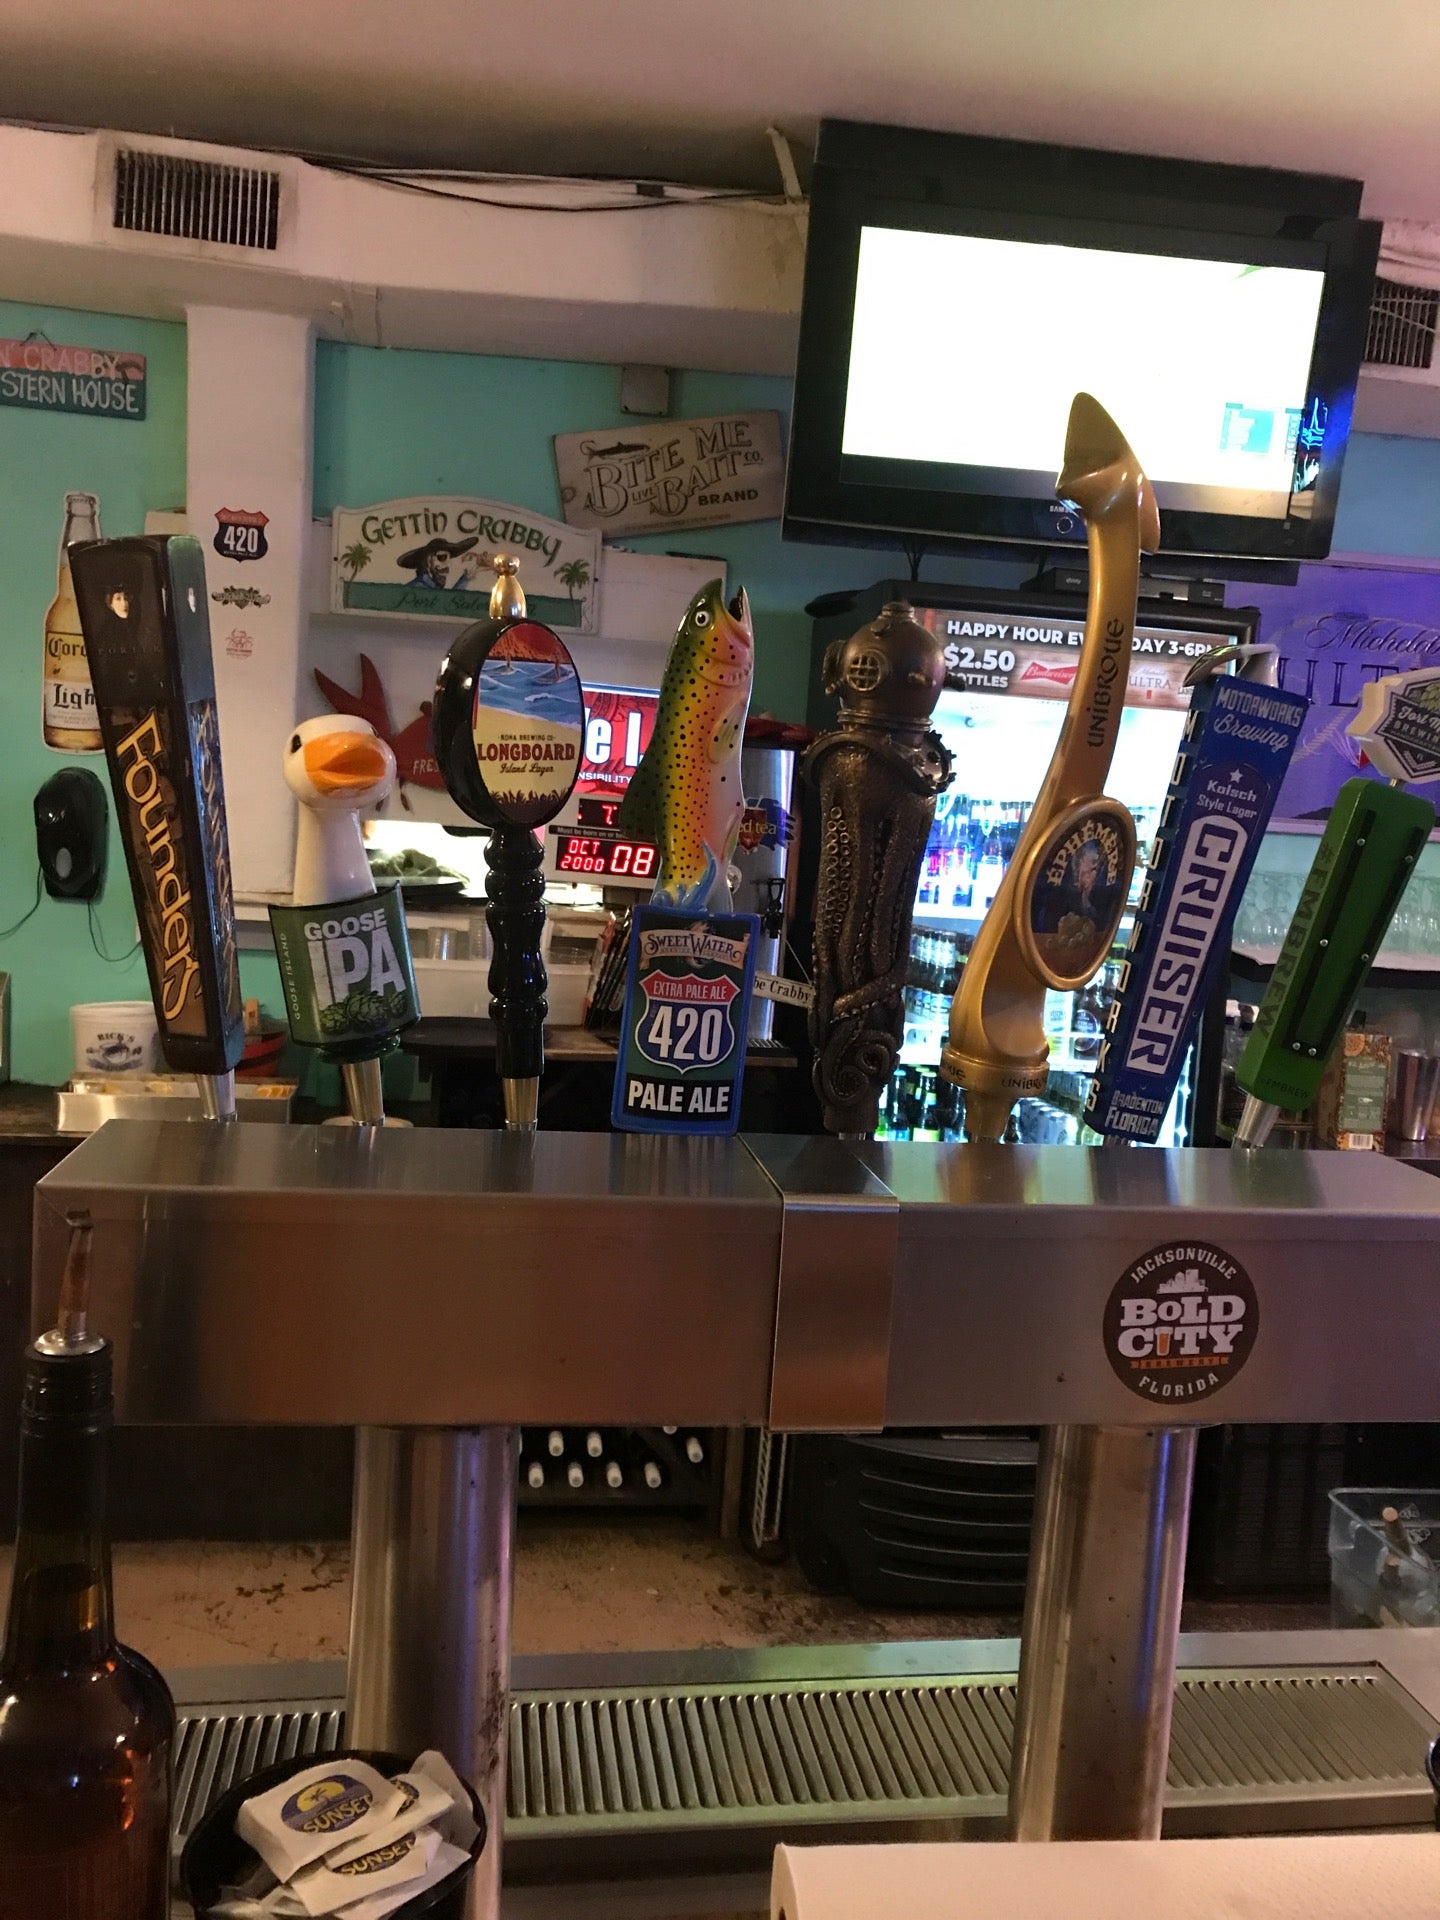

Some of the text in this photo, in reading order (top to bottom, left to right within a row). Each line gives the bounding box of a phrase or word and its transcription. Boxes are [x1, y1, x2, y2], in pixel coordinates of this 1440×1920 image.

[24, 346, 119, 380] CRABBY
[72, 378, 140, 413] HOUSE
[583, 420, 752, 517] BITE ME
[650, 450, 743, 517] BAIT
[698, 489, 759, 506] BRAND
[224, 525, 259, 553] 420
[947, 620, 1008, 639] HAPPY
[1013, 627, 1063, 644] HOUR
[1168, 641, 1221, 657] 3-6P
[943, 642, 1016, 672] $2.50
[1129, 676, 1172, 690] ULTRA
[1215, 686, 1304, 728] MOTORWORKS
[1213, 714, 1289, 753] Brewing
[477, 743, 575, 761] LONGBOARD
[500, 762, 554, 776] Island Lager
[1196, 794, 1258, 819] Style Lager
[1207, 780, 1257, 802] Kolsch
[756, 822, 776, 834] tea
[116, 706, 202, 1022] Founders
[561, 855, 605, 872] 2000
[568, 839, 655, 876] OCT 08
[304, 908, 387, 941] GOOSE
[1129, 822, 1241, 1067] CRUISER
[279, 932, 301, 1020] GOOSE ISLAND
[307, 926, 406, 1011] IPA
[653, 980, 727, 1000] EXTRA PALE ALE
[770, 980, 812, 1004] Crabby
[648, 1005, 723, 1061] 420
[628, 1079, 730, 1114] PALE ALE
[1104, 1106, 1160, 1137] FLORIDA
[1130, 1248, 1237, 1284] JACKSONVILLE
[1120, 1295, 1246, 1327] BOLD
[1117, 1324, 1244, 1358] CITY
[1145, 1358, 1216, 1369] BREWERY
[1138, 1372, 1219, 1397] FLORIDA
[303, 1794, 371, 1833] SUNSET
[341, 1839, 416, 1874] SUNSET
